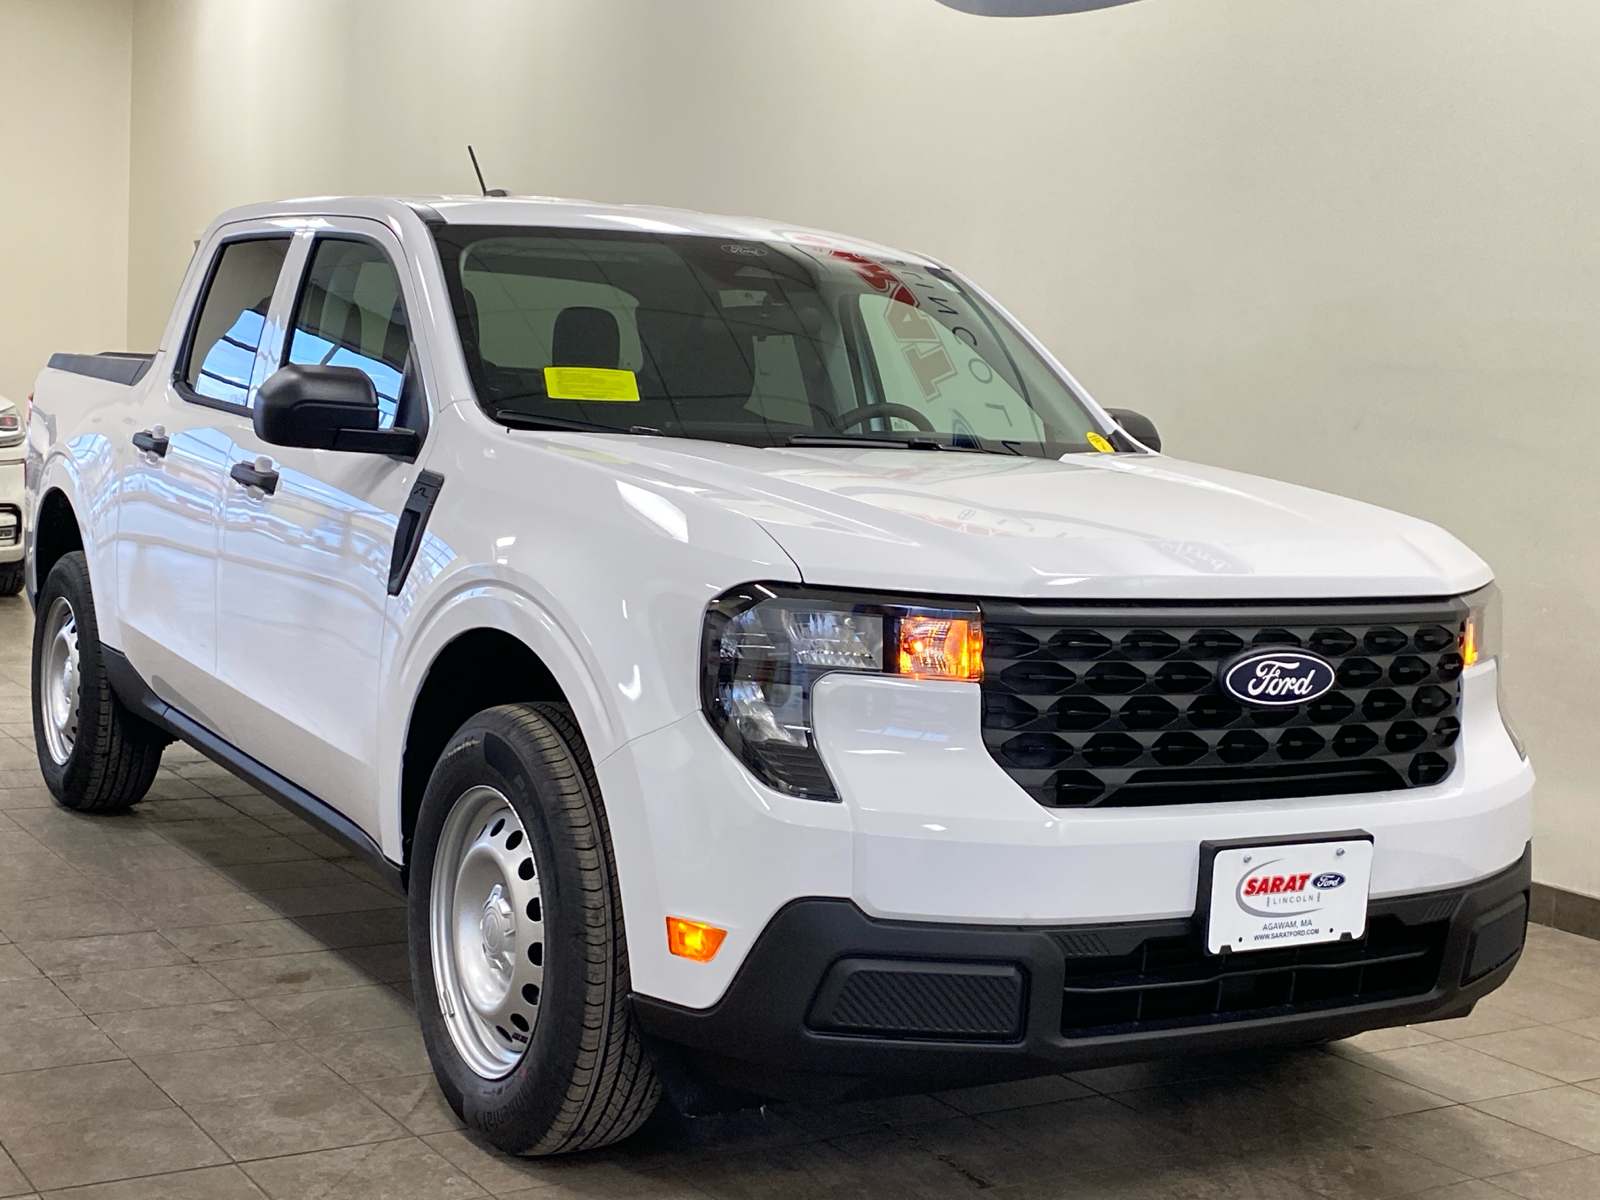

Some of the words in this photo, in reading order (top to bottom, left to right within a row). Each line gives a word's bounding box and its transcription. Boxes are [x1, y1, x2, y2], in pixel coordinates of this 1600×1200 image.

[1247, 660, 1316, 696] Ford
[1243, 873, 1312, 896] SARAT
[1273, 895, 1314, 904] LINCOLN
[1262, 920, 1298, 931] AGAWAM,
[1300, 919, 1312, 927] MA
[1254, 929, 1319, 940] WWW.SARATFORD.COM
